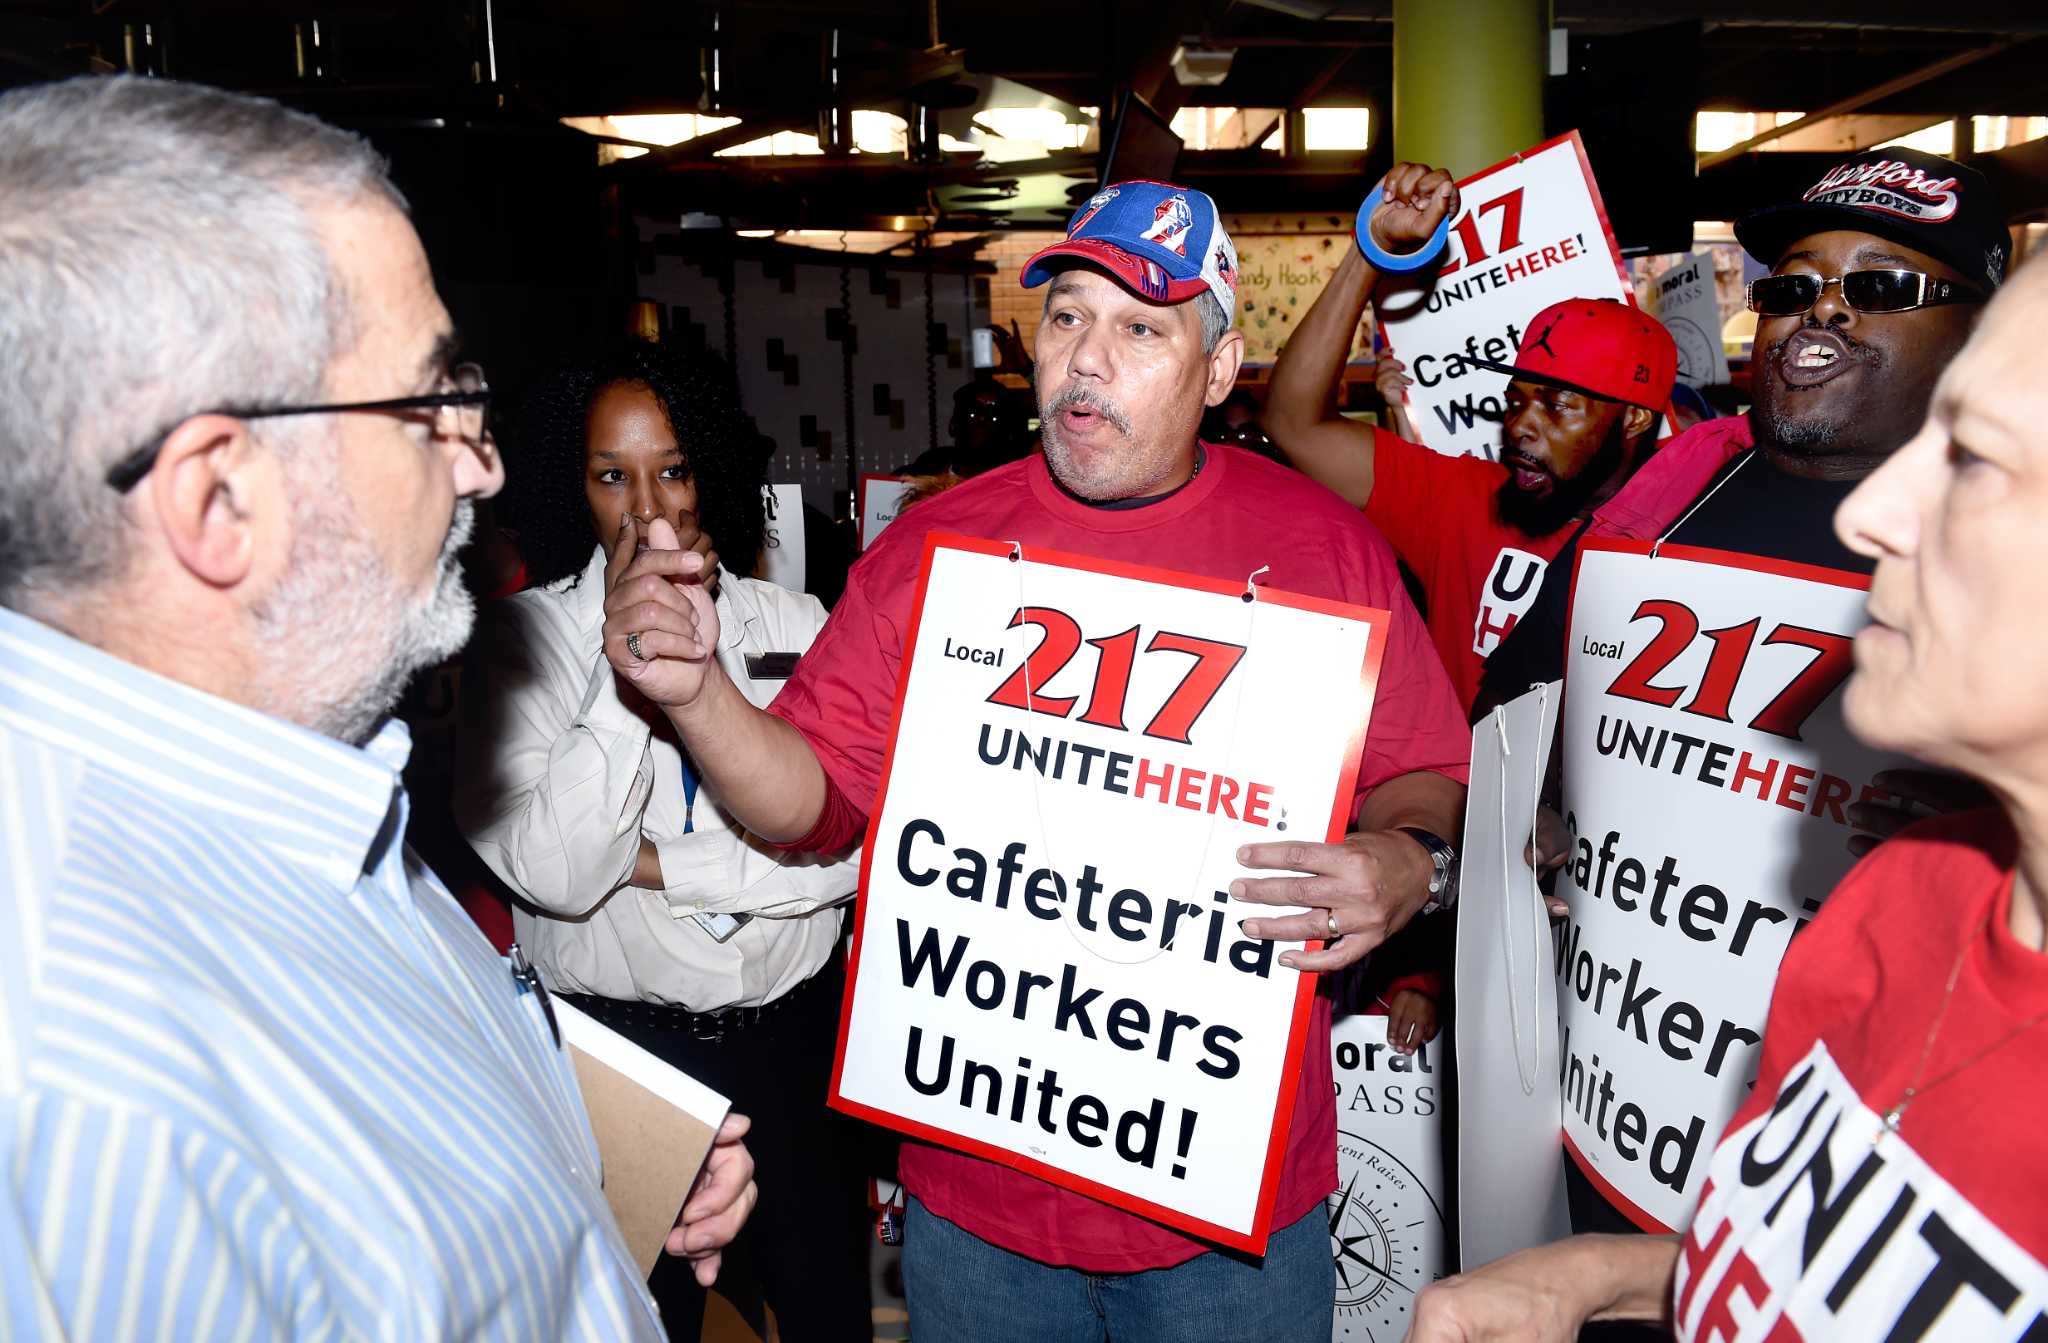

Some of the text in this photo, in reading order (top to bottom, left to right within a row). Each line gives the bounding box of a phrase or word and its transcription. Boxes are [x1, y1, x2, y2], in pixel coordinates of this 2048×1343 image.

[1437, 186, 1524, 279] 17
[1803, 160, 1959, 200] Hartford
[1279, 263, 1322, 285] Hook
[1633, 364, 1651, 383] 23
[943, 606, 1248, 745] Local 217
[1582, 599, 1855, 742] Local 217
[897, 818, 1275, 979] Cafeteria
[896, 917, 1244, 1080] Workers
[1552, 915, 1767, 1090] Worker
[904, 1025, 1199, 1181] United!
[1366, 1155, 1407, 1190] Raises
